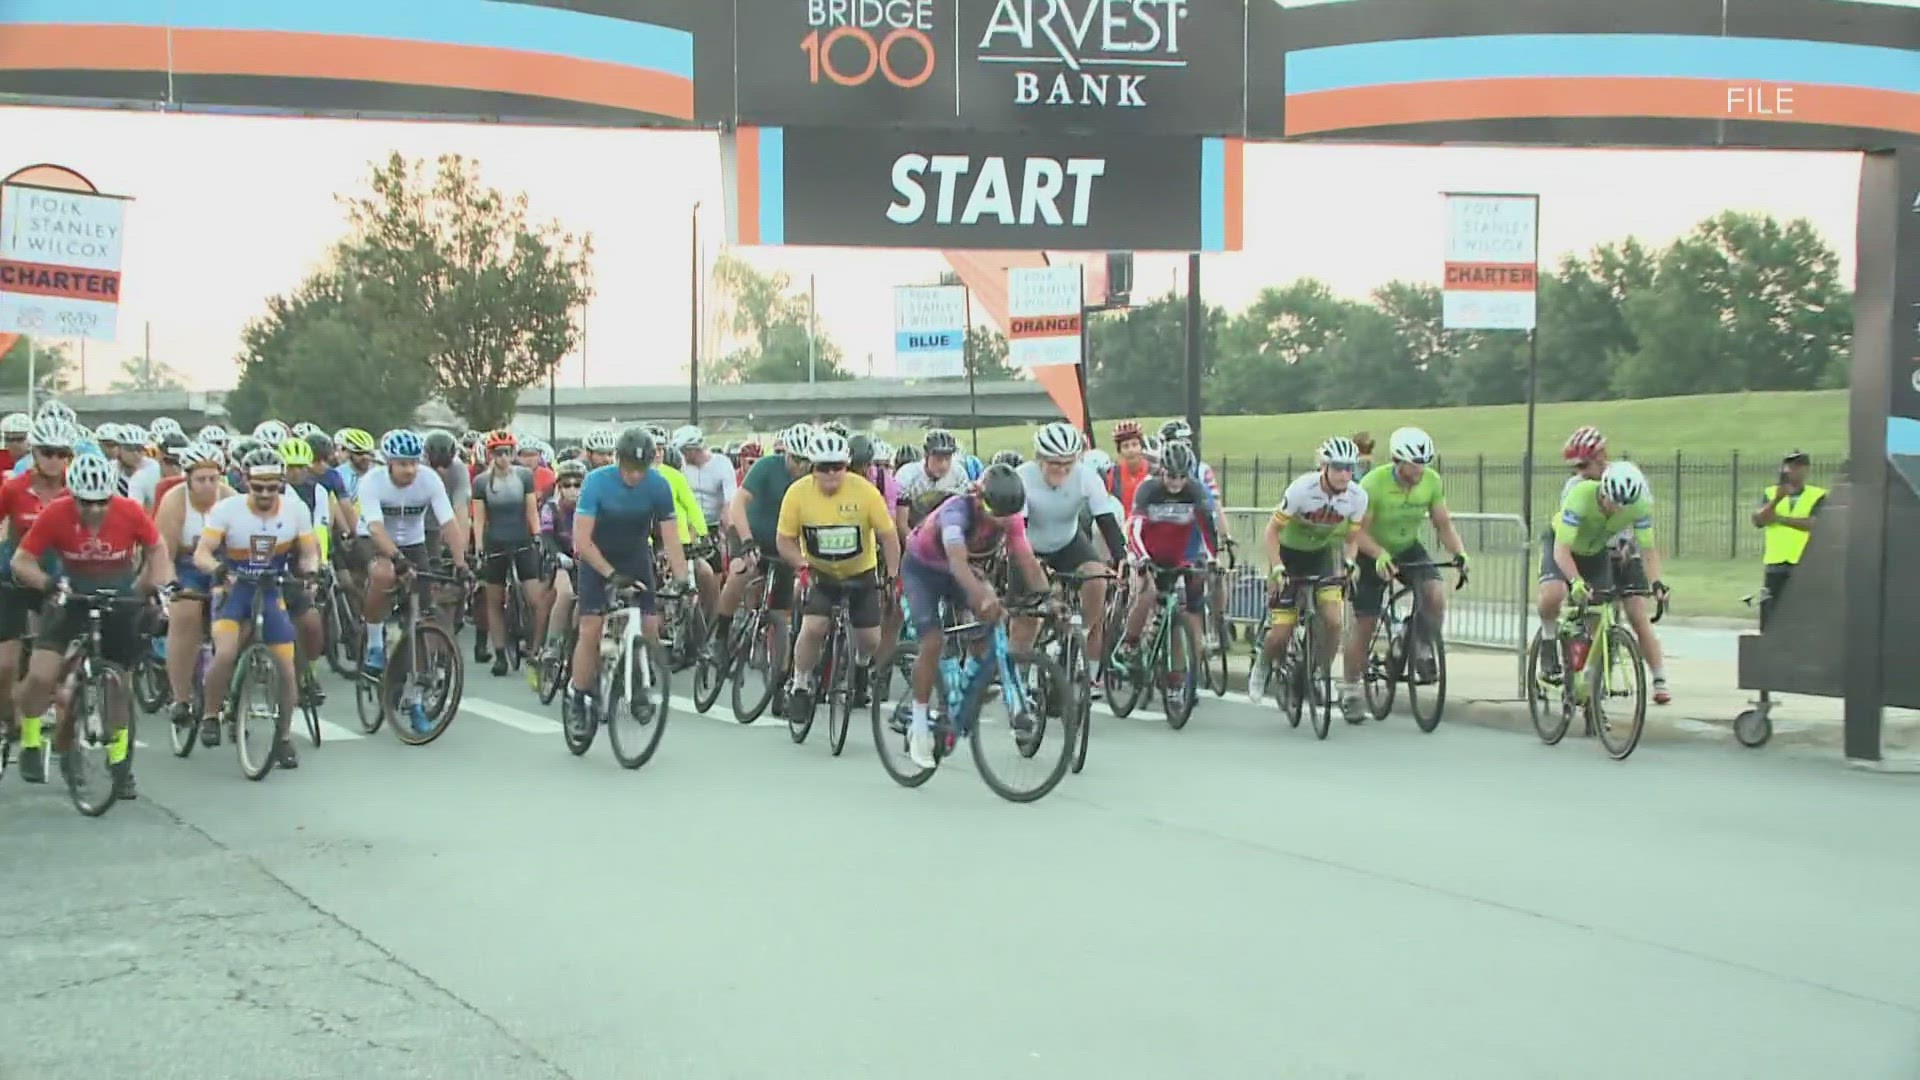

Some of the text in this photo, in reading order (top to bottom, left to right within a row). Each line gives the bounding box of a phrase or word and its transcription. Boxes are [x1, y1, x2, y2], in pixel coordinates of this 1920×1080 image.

[808, 0, 933, 29] BRIDGE
[800, 26, 936, 88] 100
[1014, 72, 1147, 107] BANK
[886, 153, 1106, 227] START
[29, 217, 118, 239] STANLEY
[28, 237, 108, 258] WILCOX
[0, 266, 118, 294] CHARTER
[1446, 266, 1533, 284] CHARTER
[1011, 317, 1079, 333] ORANGE
[909, 335, 950, 348] BLUE
